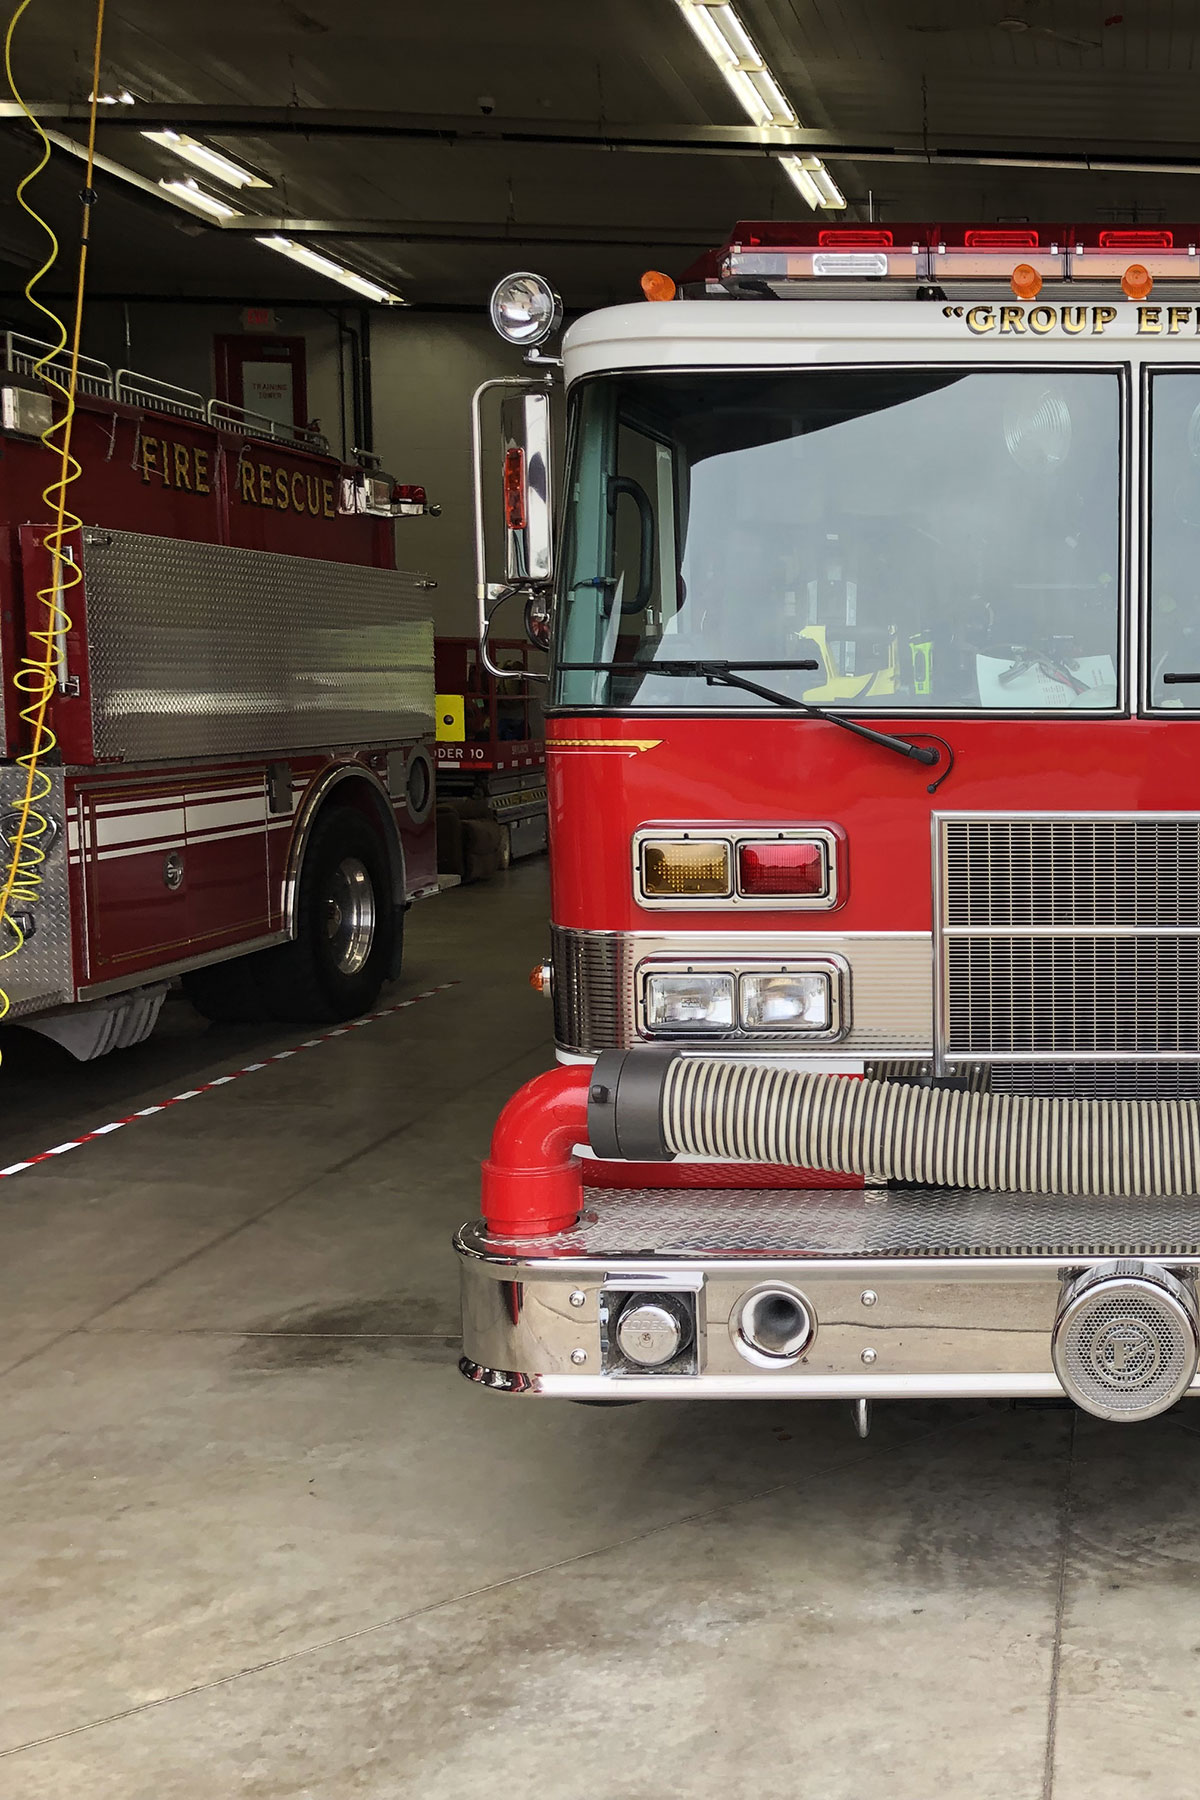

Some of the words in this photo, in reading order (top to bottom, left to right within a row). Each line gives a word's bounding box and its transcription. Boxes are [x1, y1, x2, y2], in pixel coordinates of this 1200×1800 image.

[942, 305, 1118, 336] “GROUP
[141, 435, 211, 495] FIRE
[240, 459, 336, 519] RESCUE
[470, 748, 484, 759] 10
